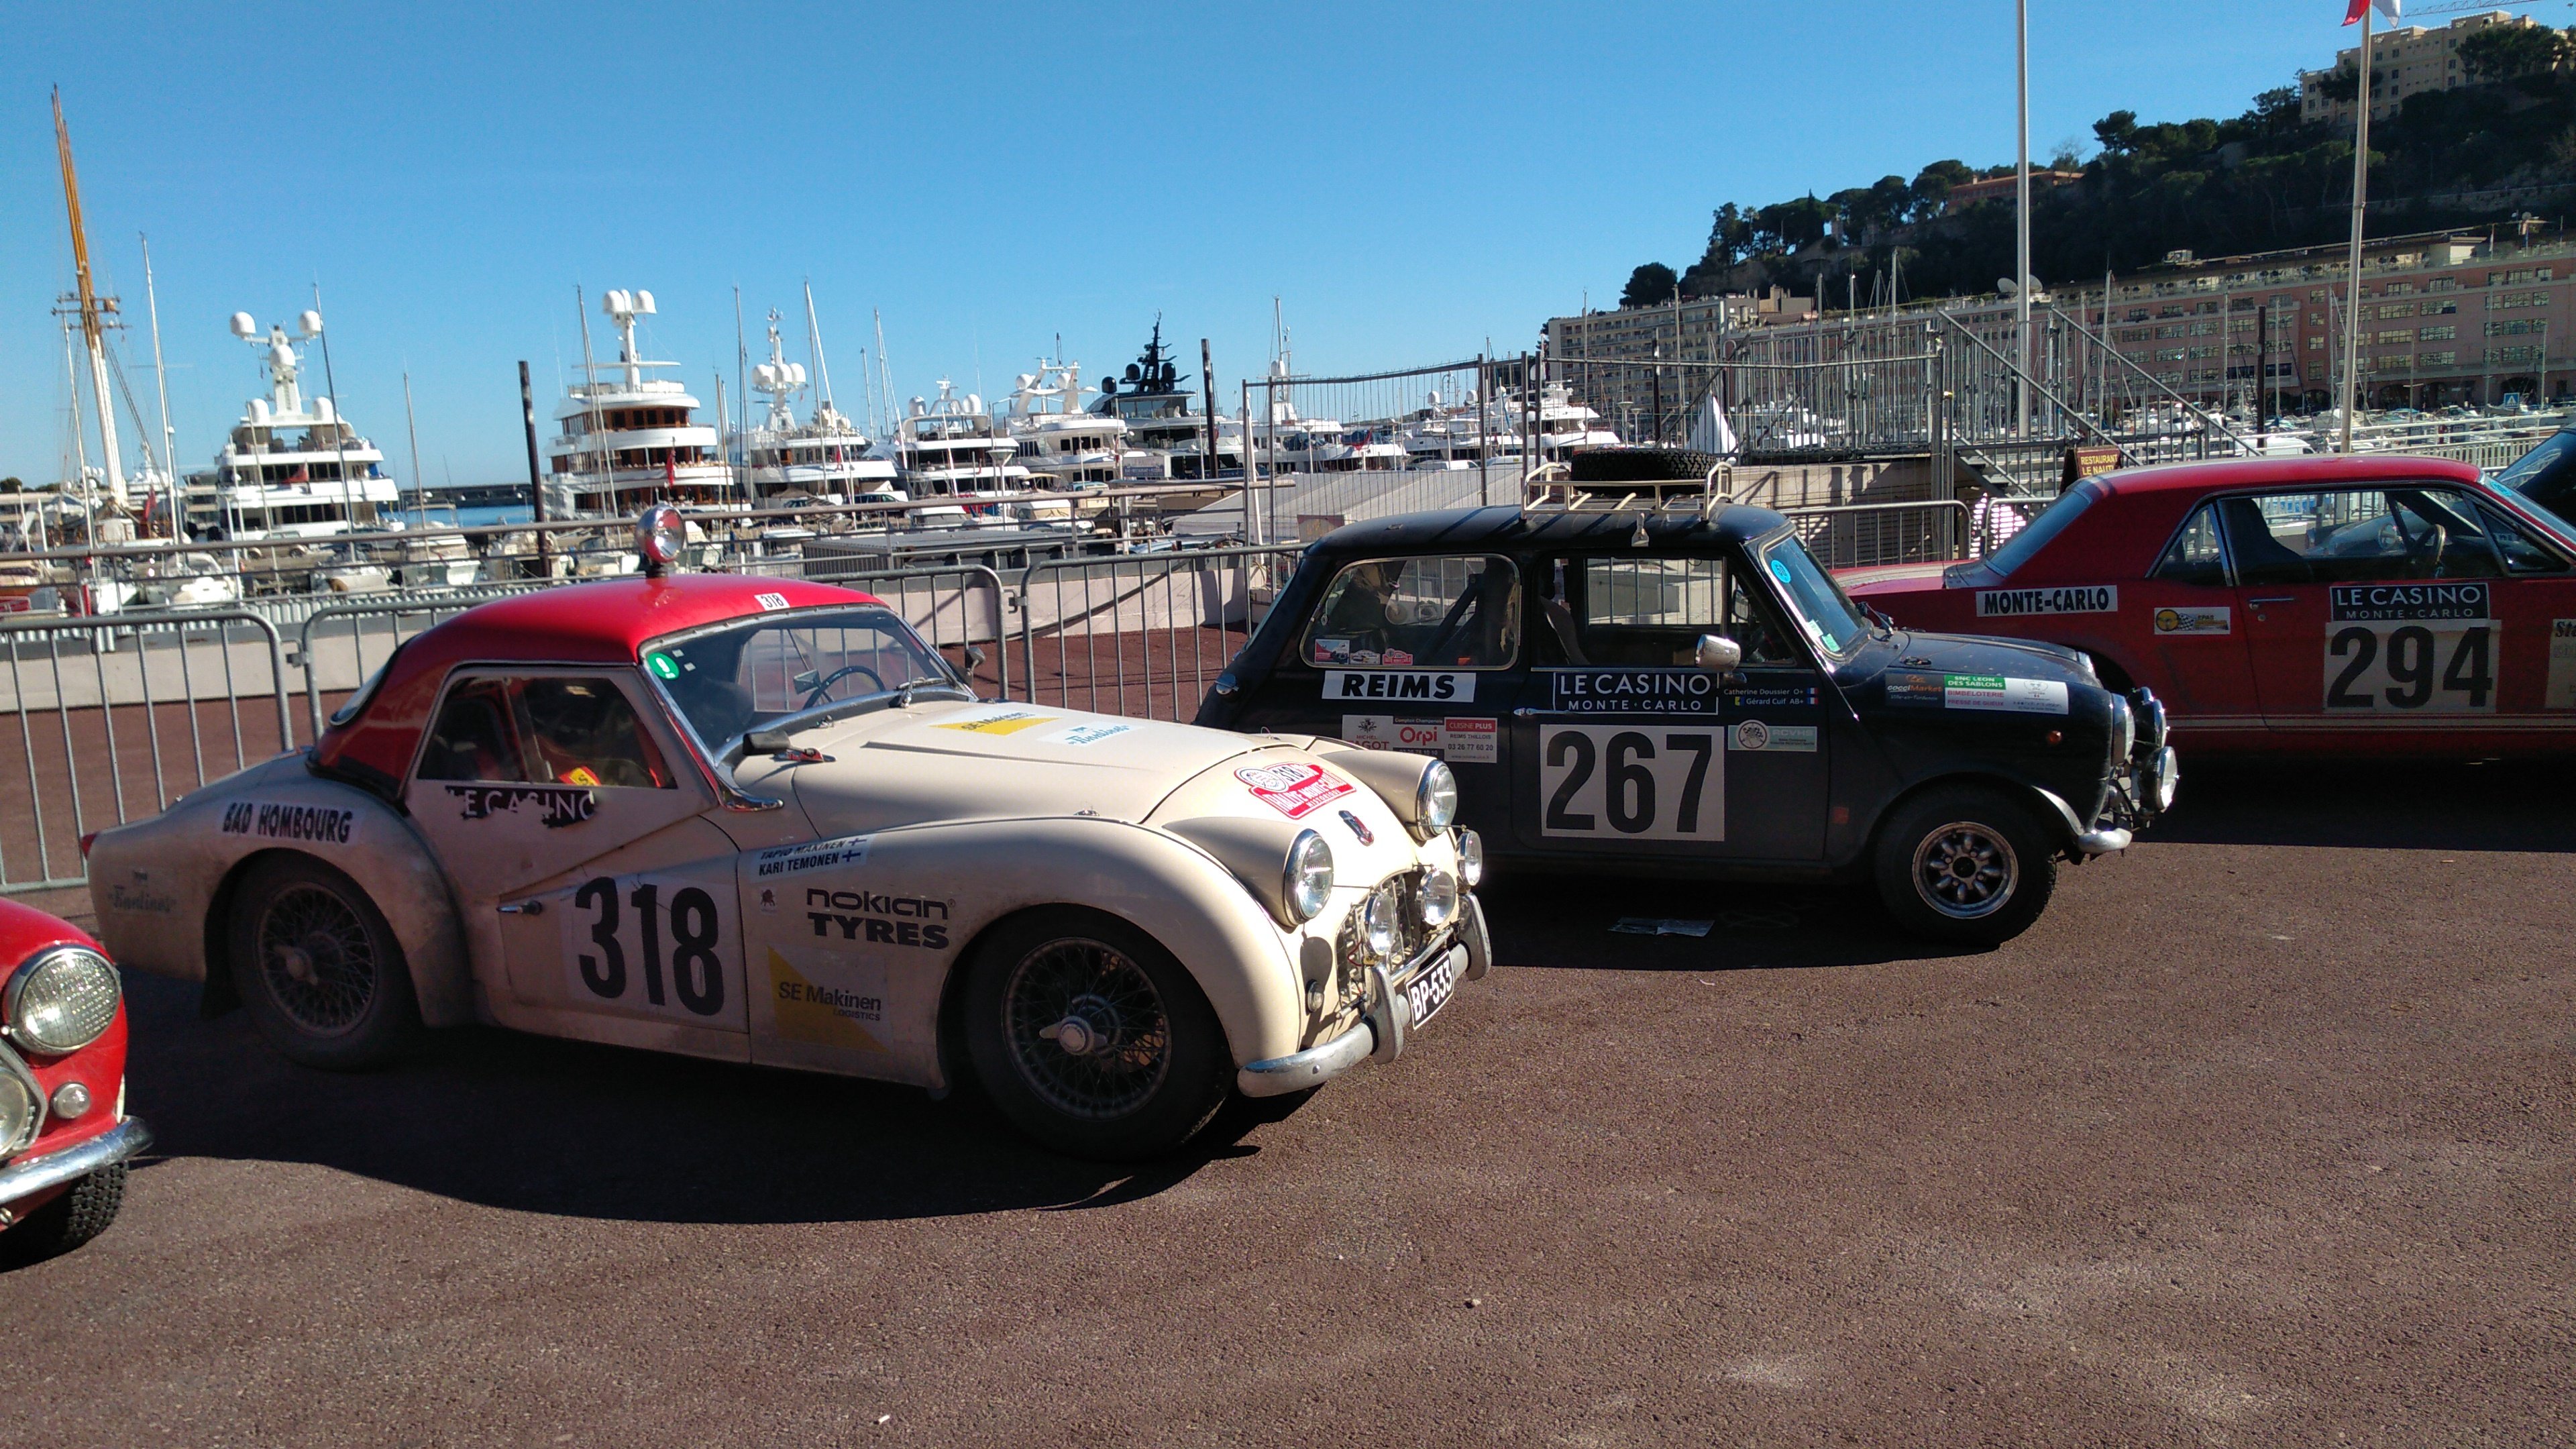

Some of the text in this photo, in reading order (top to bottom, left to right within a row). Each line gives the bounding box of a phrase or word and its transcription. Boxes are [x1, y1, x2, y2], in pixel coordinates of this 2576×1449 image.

[2080, 454, 2118, 465] RESTAURANT
[2082, 466, 2092, 476] LE
[760, 594, 784, 608] 318
[1984, 587, 2109, 614] MONTE-CARLO
[2337, 586, 2481, 606] LE CASINO
[2346, 608, 2474, 619] MONTE CARLO
[2326, 626, 2493, 708] 294
[1342, 673, 1455, 699] REIMS
[1560, 674, 1711, 695] LE CASINO
[1947, 690, 2004, 698] BIMBELOTERIE
[1568, 700, 1702, 711] MONTE CARLO
[1344, 740, 1389, 751] AGOT
[1399, 726, 1438, 746] Orpi
[1273, 766, 1305, 782] 318
[1546, 731, 1712, 834] 267
[223, 802, 353, 843] BAD HOMBOURG
[761, 848, 793, 860] TAPIO
[759, 853, 839, 876] KARI TEMONEN
[808, 912, 949, 950] TYRES
[575, 876, 724, 1016] 318
[779, 981, 802, 1001] SE
[1411, 959, 1452, 1021] BP-533
[833, 1009, 881, 1021] LOGISTICS
